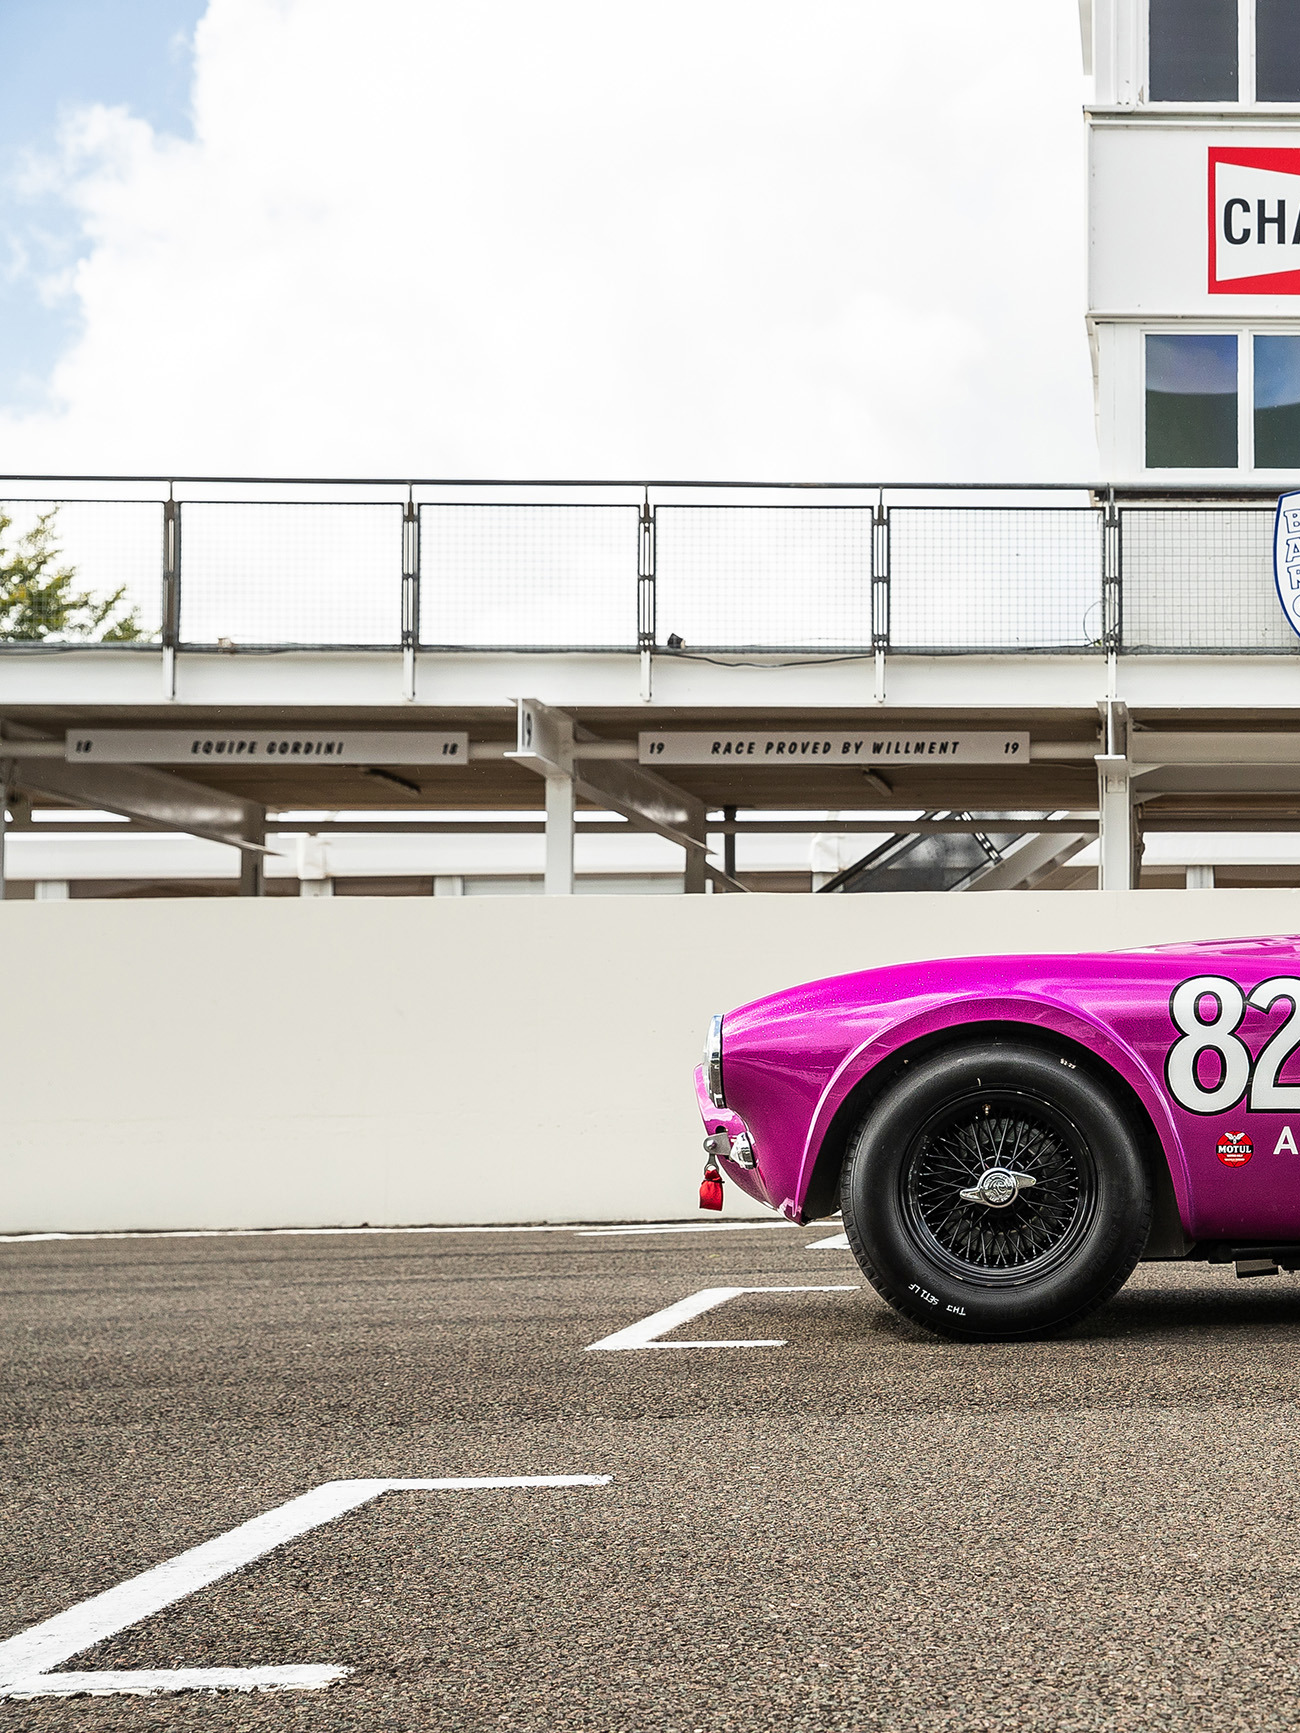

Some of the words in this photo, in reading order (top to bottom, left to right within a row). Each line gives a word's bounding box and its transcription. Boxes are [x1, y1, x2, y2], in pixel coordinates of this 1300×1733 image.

[191, 740, 258, 755] EQUIPE
[266, 741, 344, 755] GORDINI
[649, 741, 665, 754] 19
[711, 740, 755, 755] RACE
[765, 741, 835, 755] PROVED
[841, 741, 864, 755] BY
[872, 741, 960, 755] WILLMENT
[1004, 741, 1020, 754] 19
[1218, 1145, 1252, 1154] MOTUL
